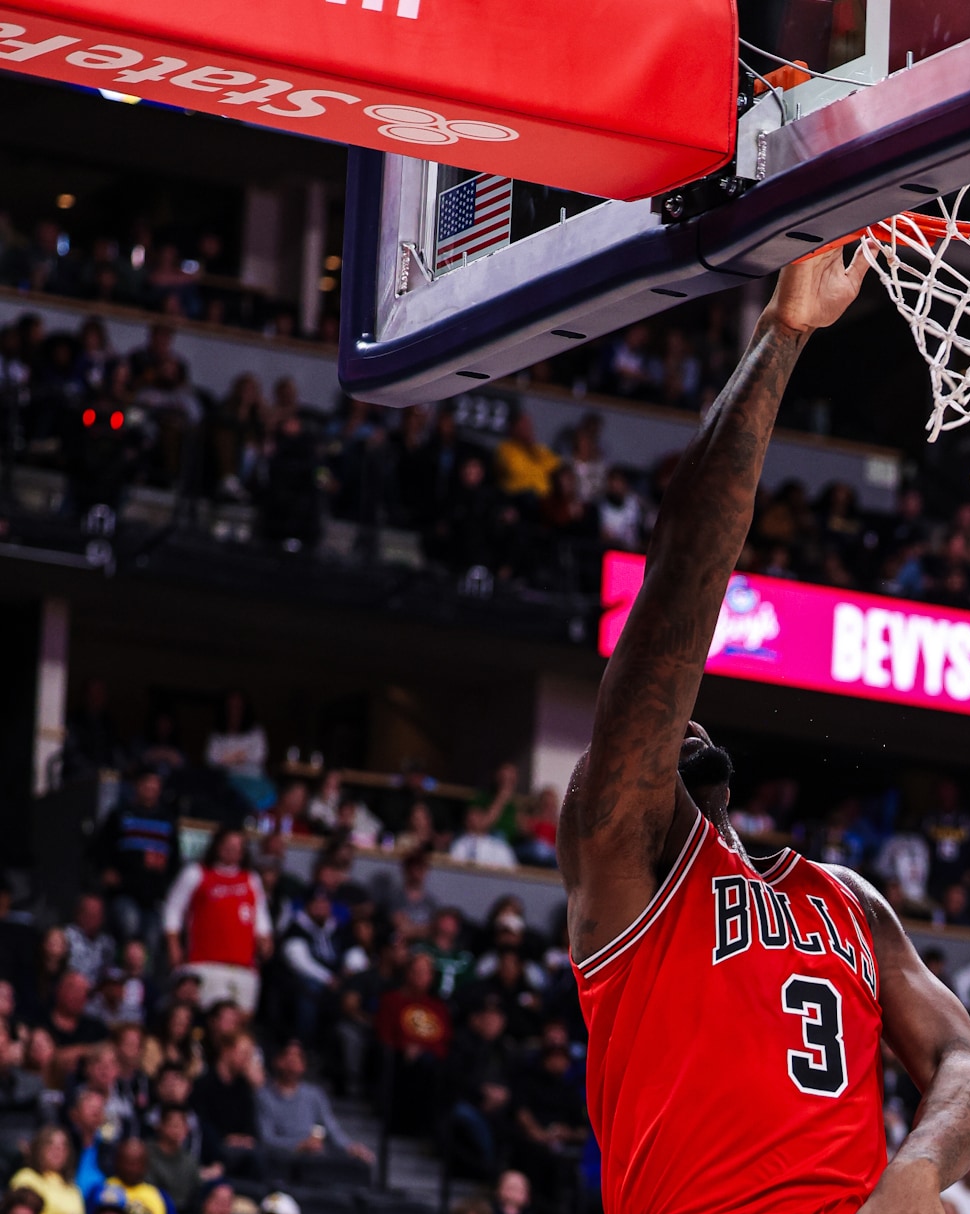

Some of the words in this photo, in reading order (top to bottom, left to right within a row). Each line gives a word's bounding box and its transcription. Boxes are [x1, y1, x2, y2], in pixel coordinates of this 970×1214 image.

[66, 38, 361, 119] State
[712, 874, 877, 1001] BULLS
[781, 973, 849, 1098] 3
